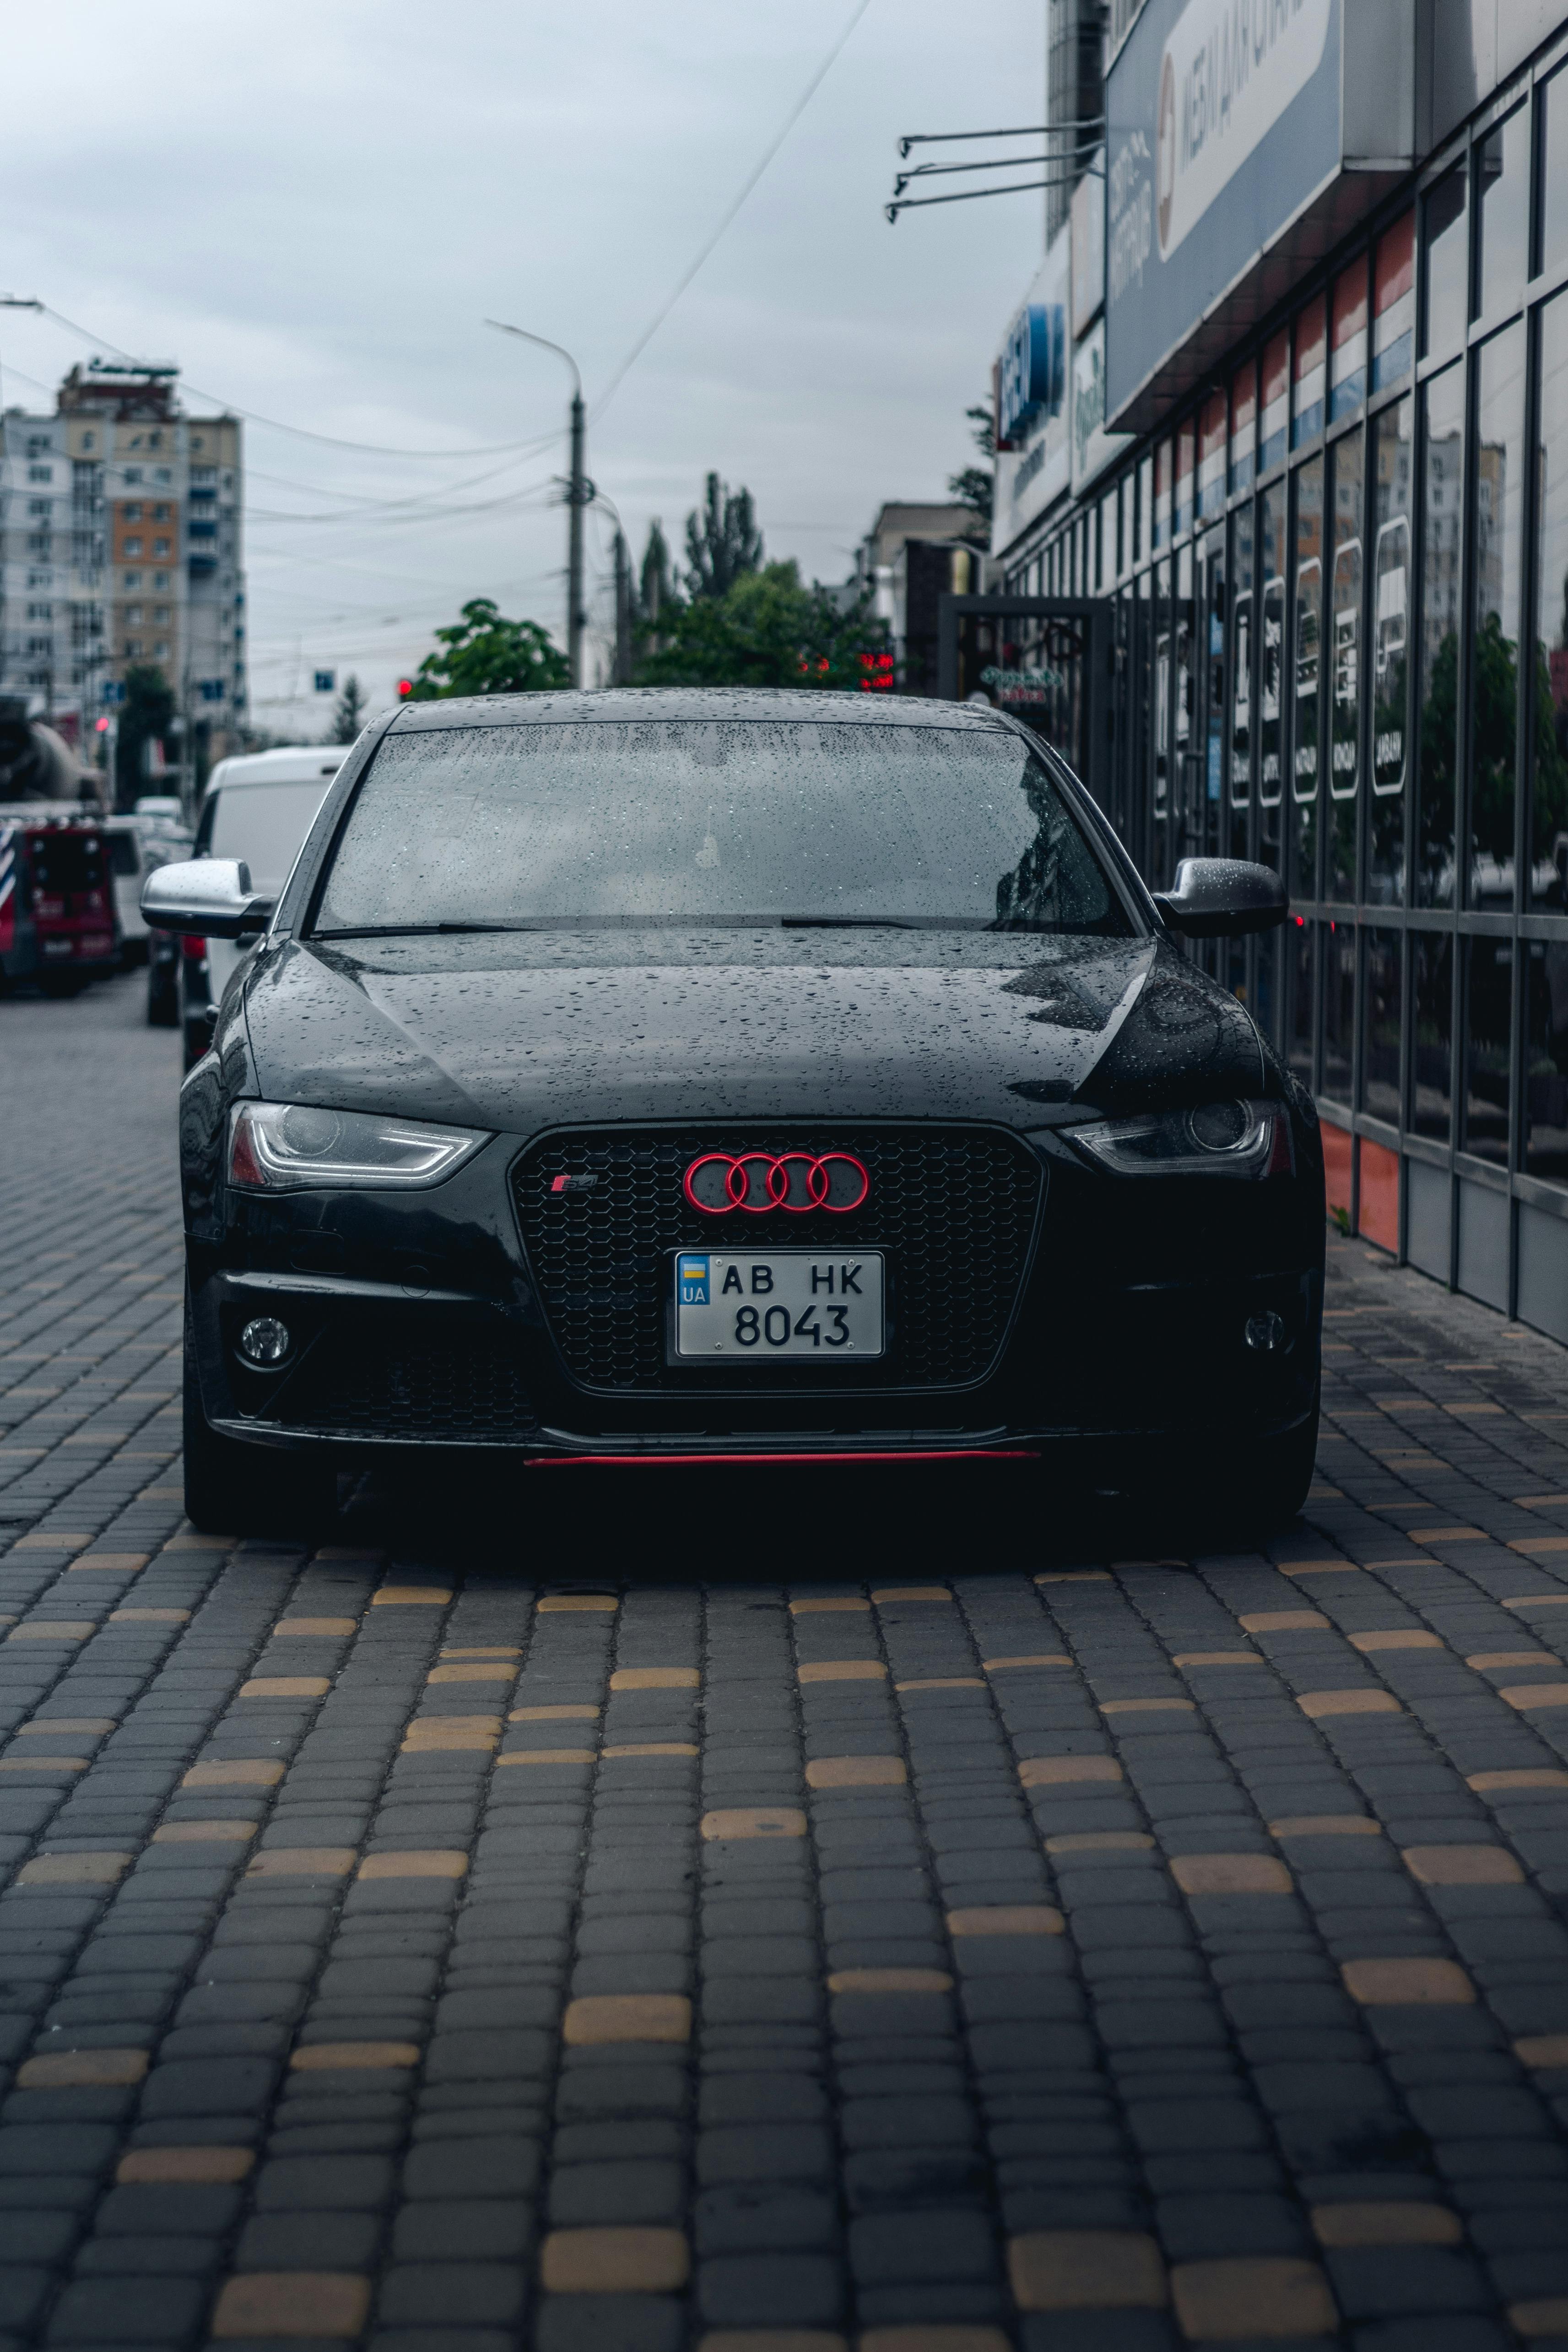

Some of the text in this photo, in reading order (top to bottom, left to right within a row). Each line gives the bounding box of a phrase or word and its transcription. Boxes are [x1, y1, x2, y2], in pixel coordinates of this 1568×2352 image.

[722, 1265, 863, 1294] AB HK
[683, 1287, 706, 1303] UA
[735, 1304, 850, 1346] 8043
